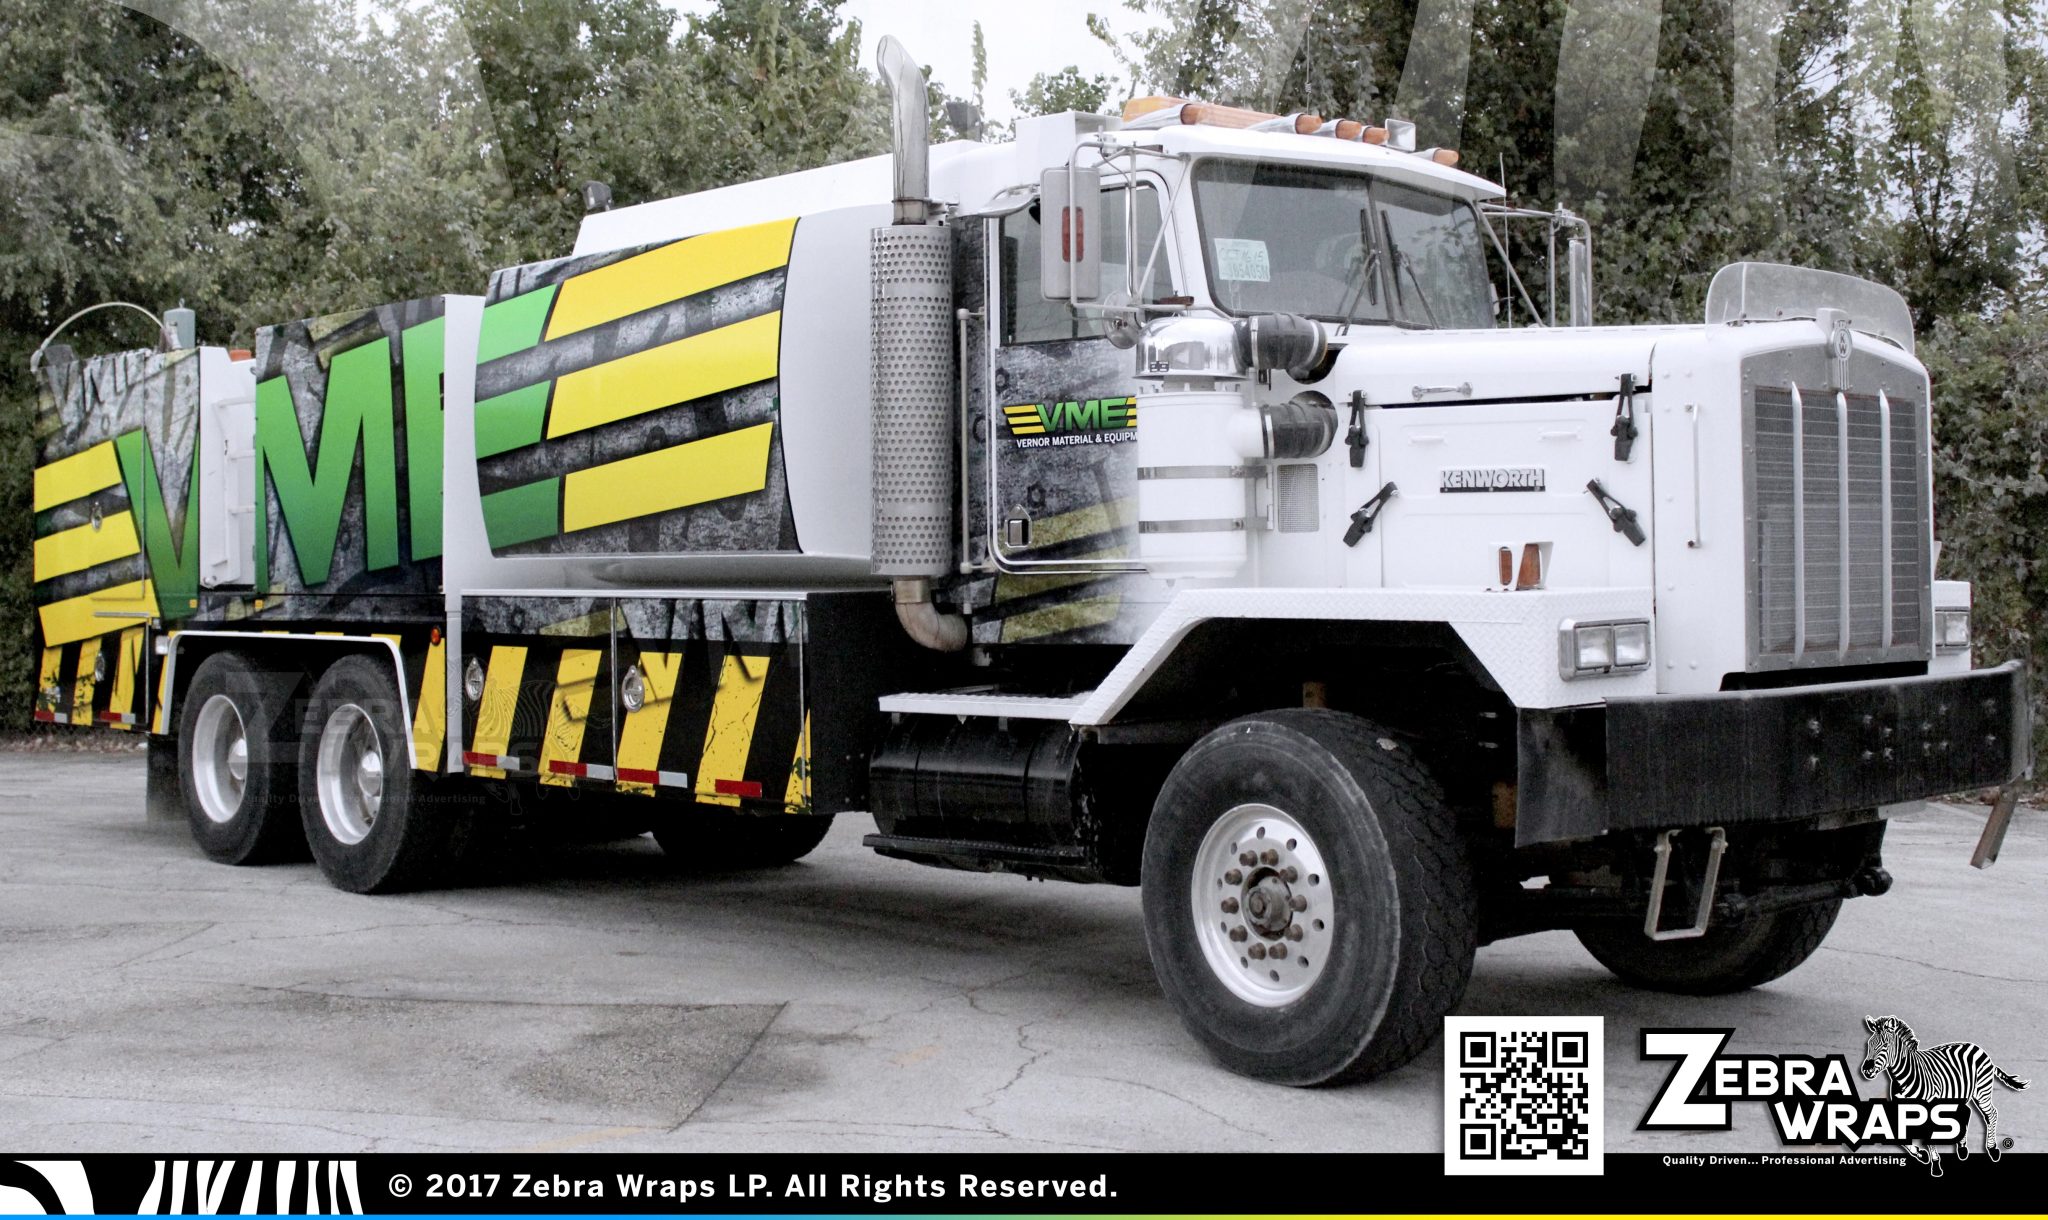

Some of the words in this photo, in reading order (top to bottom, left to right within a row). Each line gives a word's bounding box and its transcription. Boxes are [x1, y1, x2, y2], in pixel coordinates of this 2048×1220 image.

[1036, 397, 1128, 433] VME
[1016, 437, 1050, 449] VERNOR
[1052, 434, 1094, 446] MATERIAL
[1096, 434, 1102, 443] &
[1440, 468, 1545, 488] KENWORTH
